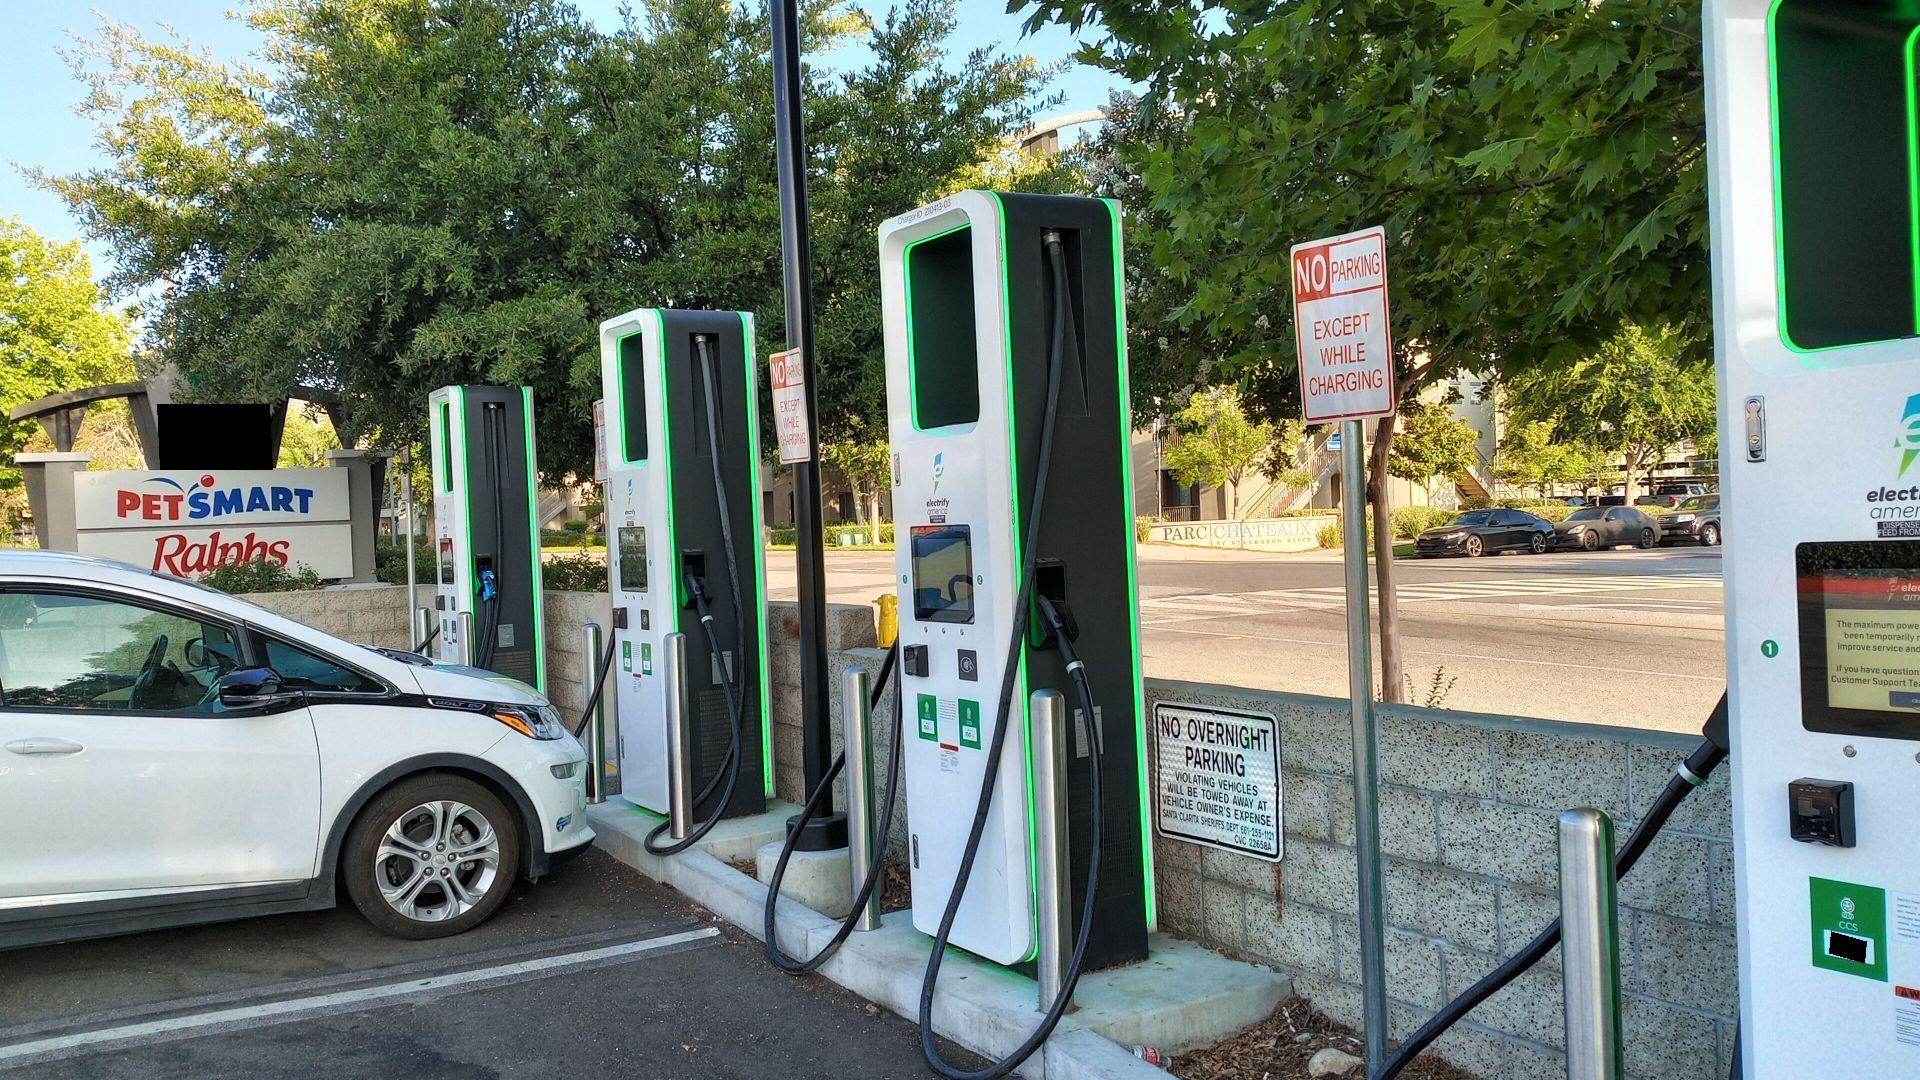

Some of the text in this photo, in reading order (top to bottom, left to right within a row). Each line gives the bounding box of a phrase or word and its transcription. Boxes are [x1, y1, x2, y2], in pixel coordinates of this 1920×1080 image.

[897, 212, 917, 224] Charger
[1296, 251, 1381, 296] NO PARKING
[1313, 312, 1371, 341] EXCEPT
[1320, 342, 1366, 367] WHILE
[772, 360, 785, 385] NO
[1308, 368, 1384, 397] CHARGING
[780, 398, 800, 414] EXCEPT
[783, 416, 800, 429] WHILE
[780, 432, 807, 447] CHARGING
[1866, 485, 1920, 502] elect
[117, 484, 314, 521] PETSMART
[926, 498, 950, 508] electrify
[1163, 522, 1311, 540] PARC CHATEAUX
[1877, 528, 1898, 537] FEED
[1837, 620, 1920, 632] The maximum powe
[1844, 631, 1864, 640] been
[1866, 632, 1915, 643] temporarily
[1837, 642, 1871, 652] improve
[1872, 643, 1904, 653] service
[1860, 665, 1881, 675] have
[1831, 675, 1871, 685] Customer
[1872, 677, 1906, 687] Support
[1161, 716, 1269, 752] NO OVERNIGHT
[1185, 745, 1246, 778] PARKING
[1175, 771, 1259, 797] VIOLATING VEHICLES
[1167, 782, 1268, 812] WILL BE TOWED AWAY AT
[1162, 794, 1275, 828] VEHICLE OWNER'S EXPENSE.
[1162, 808, 1178, 819] SANTA
[1179, 811, 1200, 824] CLARITA
[1226, 821, 1239, 833] DEPT
[1234, 834, 1247, 846] CVC
[1838, 920, 1859, 932] CCS
